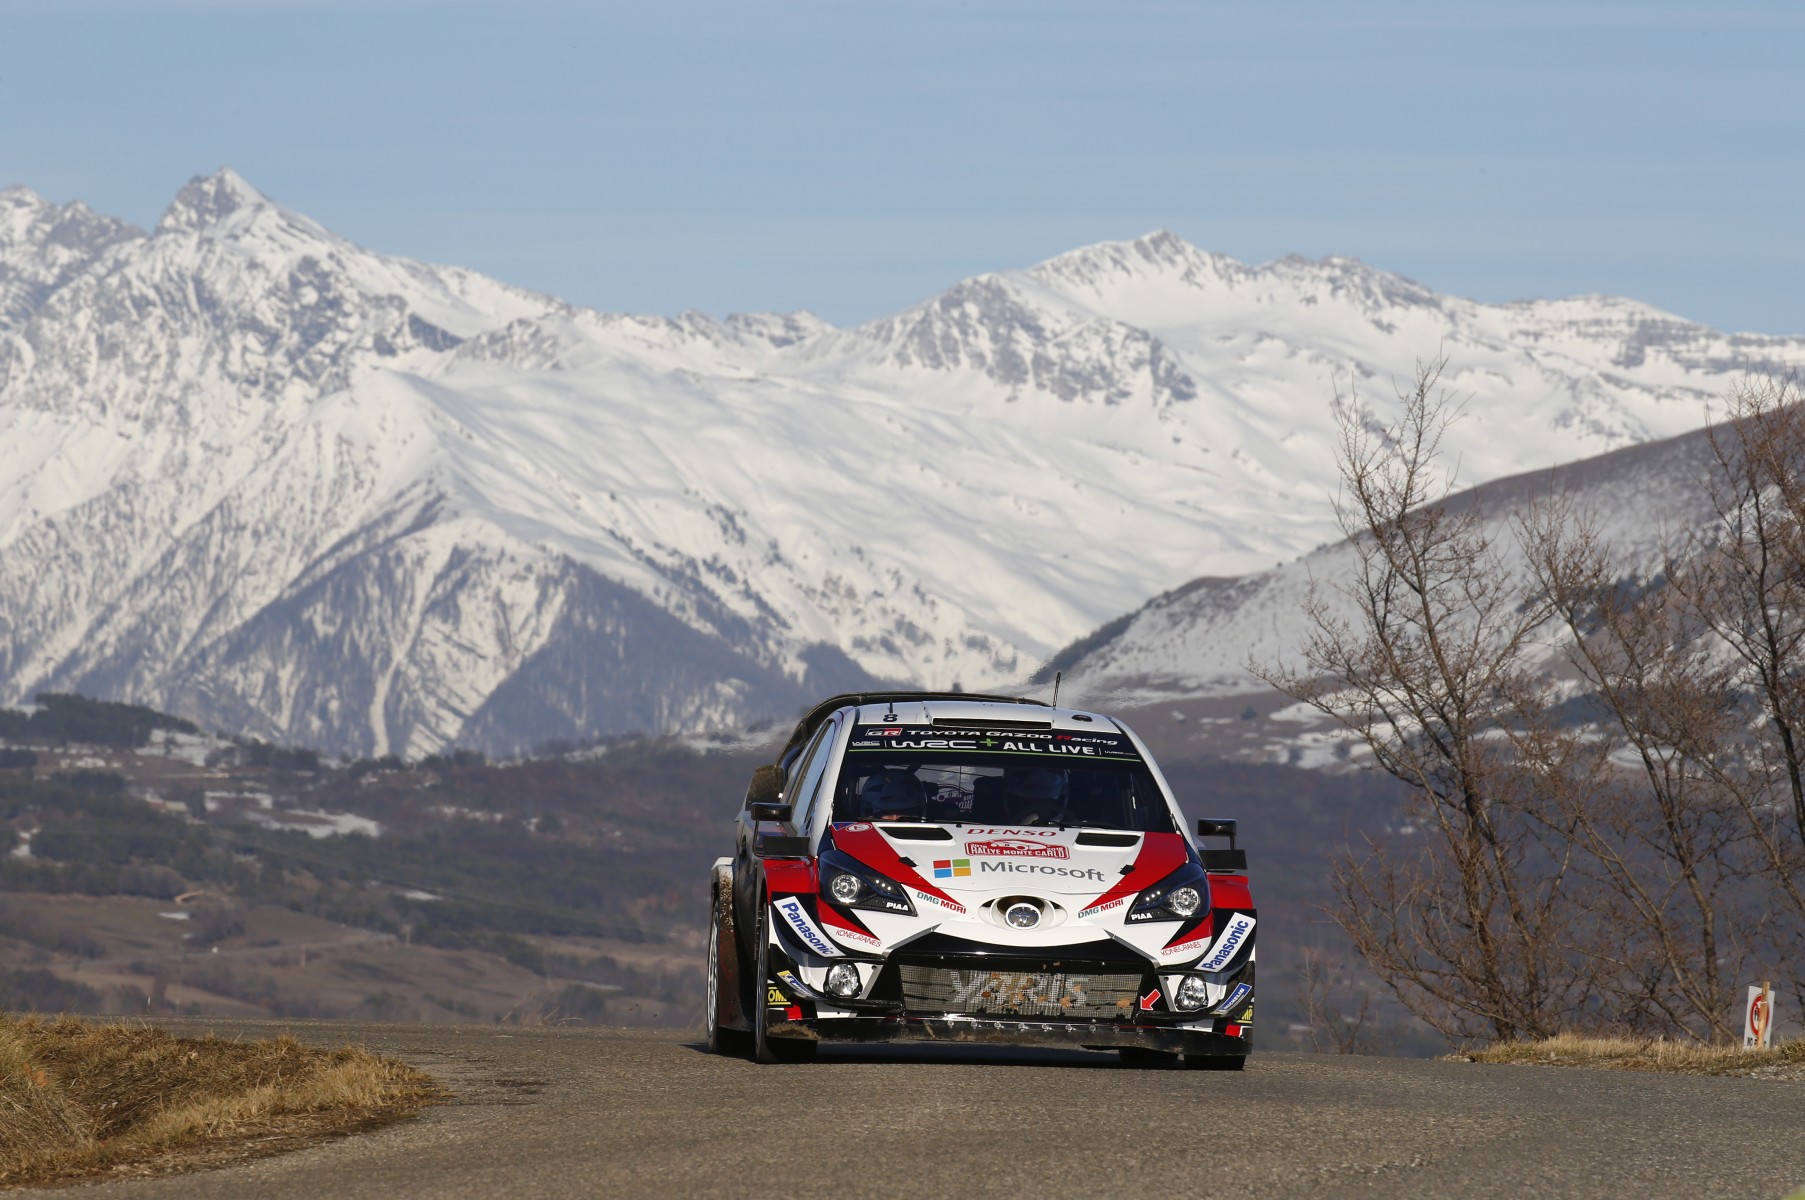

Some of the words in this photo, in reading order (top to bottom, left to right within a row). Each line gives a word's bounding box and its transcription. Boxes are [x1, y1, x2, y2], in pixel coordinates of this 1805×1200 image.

[883, 714, 898, 722] 8
[866, 728, 901, 736] GR
[985, 731, 1053, 739] GAZOO
[1056, 735, 1118, 746] Racing
[1003, 741, 1043, 752] ALL
[1048, 744, 1095, 755] LIVE
[966, 828, 1057, 837] DENSO
[970, 846, 1001, 855] RALLYE
[980, 861, 1106, 882] Microsoft
[886, 901, 909, 911] PIAA
[916, 891, 940, 905] DMG
[940, 897, 967, 915] MORI
[1077, 907, 1099, 919] DMG
[1100, 898, 1124, 912] MORI
[1131, 912, 1153, 921] PIAA
[782, 902, 834, 955] Panasonic
[835, 929, 882, 948] KONECRANES
[1201, 920, 1249, 970] Panasonic
[1160, 941, 1202, 957] KONECRANES
[767, 989, 788, 1002] OM
